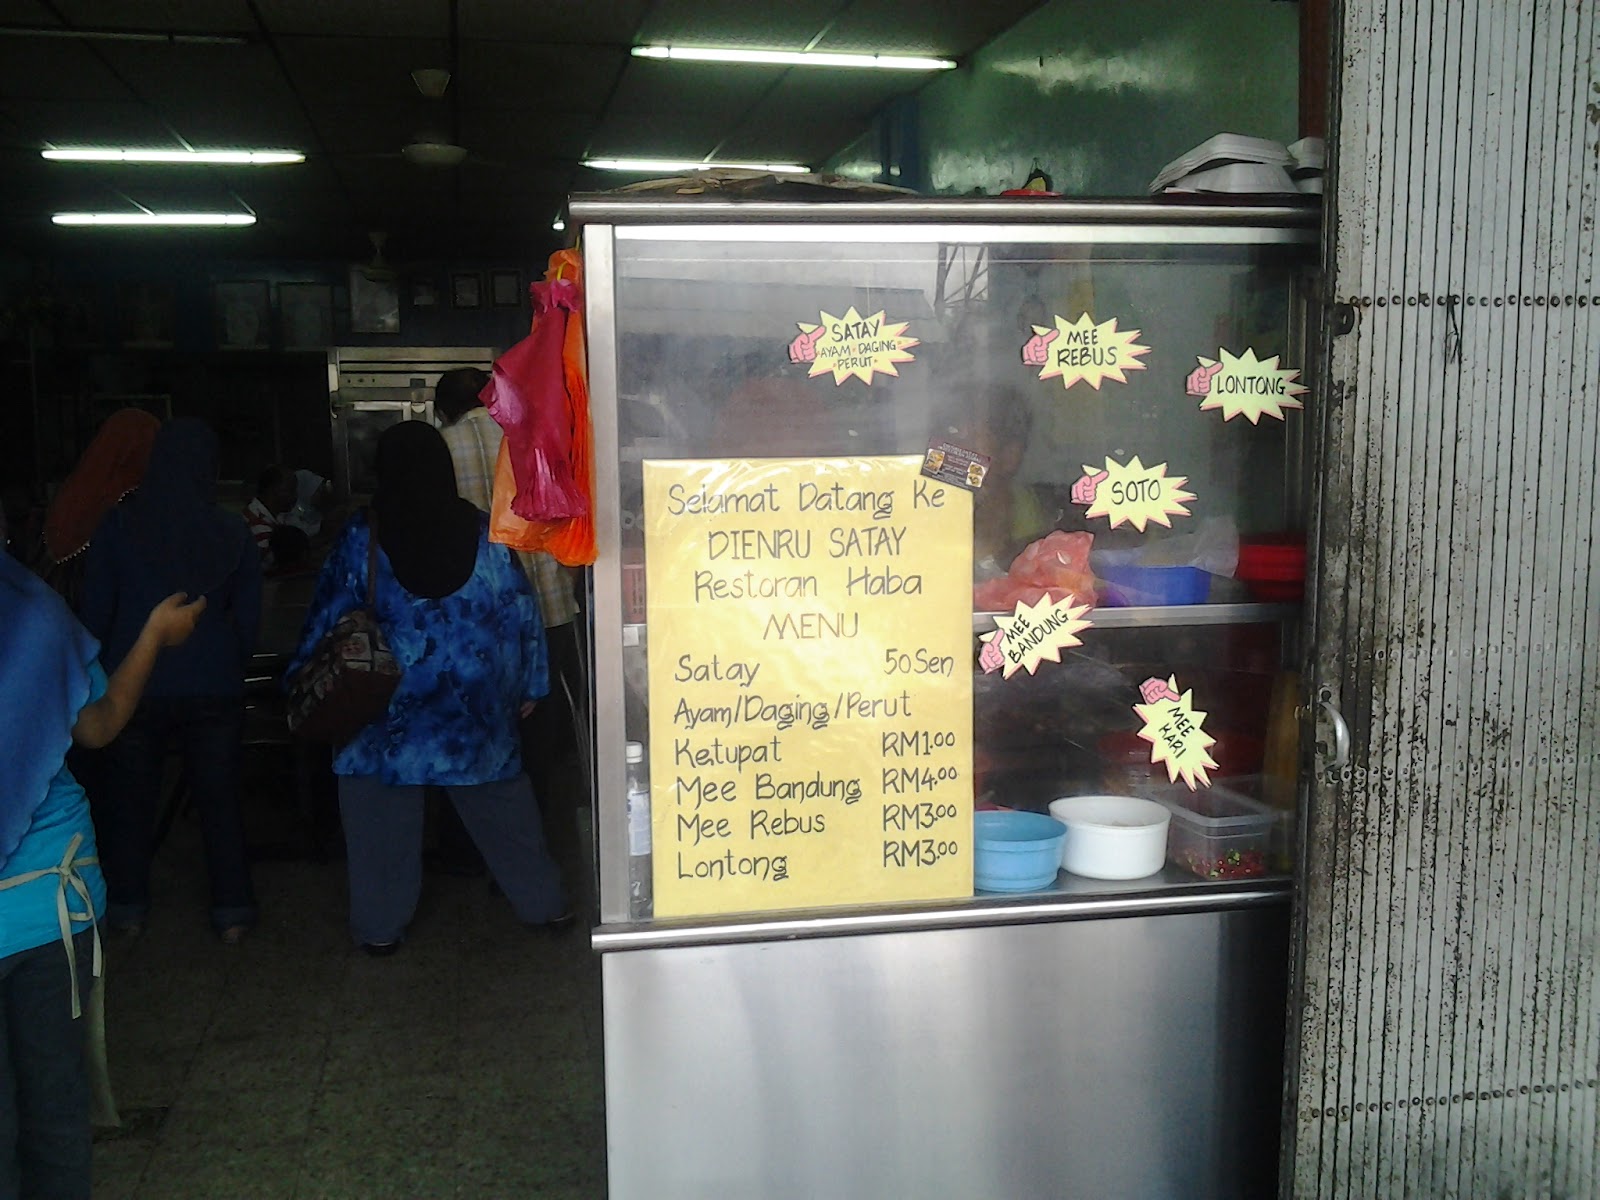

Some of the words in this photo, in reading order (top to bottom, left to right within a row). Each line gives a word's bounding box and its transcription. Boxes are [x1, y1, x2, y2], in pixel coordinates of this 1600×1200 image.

[832, 319, 880, 342] SATAY
[1067, 329, 1098, 345] MEE
[821, 346, 851, 358] AYAM
[858, 340, 897, 354] DAGING
[837, 356, 873, 370] PERUT
[1057, 347, 1117, 367] REBUS
[1217, 375, 1286, 396] LONTONG
[668, 482, 780, 516] Selamat
[798, 482, 895, 519] Datang
[913, 479, 945, 510] Ke
[1111, 479, 1161, 505] SOTO
[708, 529, 811, 560] DIENRU
[829, 526, 907, 558] SATAY
[695, 569, 817, 603] Restoran
[846, 565, 922, 596] Haba
[763, 612, 858, 640] MENU
[1005, 614, 1031, 645] MEE
[1008, 608, 1069, 664] BANDUNG
[675, 654, 760, 687] Satay
[1167, 707, 1195, 738] MEE
[675, 736, 782, 773] Ketupat
[882, 731, 956, 758] RM1.00
[1158, 723, 1187, 759] KARI
[676, 776, 737, 810] Mee
[755, 771, 862, 804] Bandung
[882, 767, 958, 795] RM4.00
[677, 813, 732, 846] Mee
[750, 809, 826, 839] Rebus
[883, 803, 957, 831] RM3.00
[678, 849, 789, 881] Lontong
[883, 840, 958, 868] RM3.00
